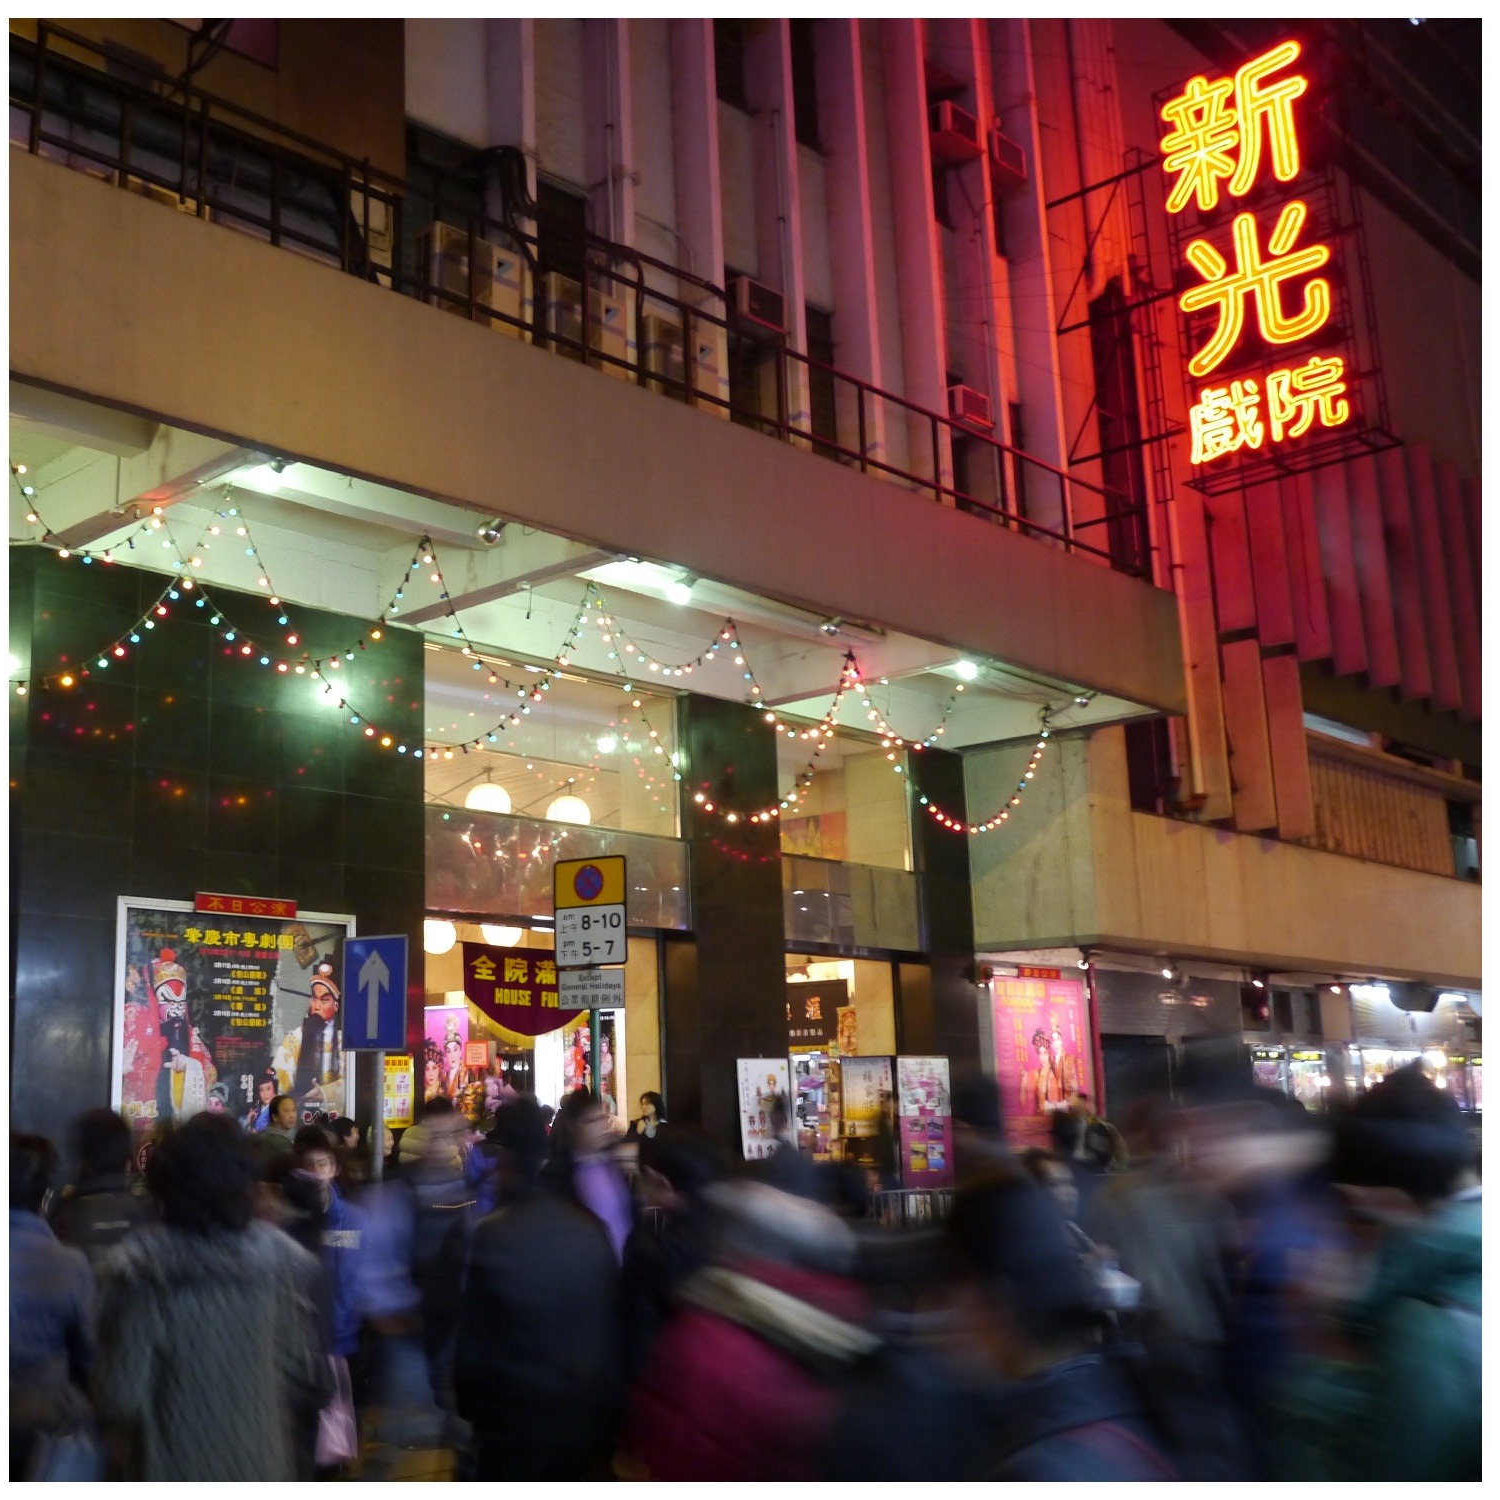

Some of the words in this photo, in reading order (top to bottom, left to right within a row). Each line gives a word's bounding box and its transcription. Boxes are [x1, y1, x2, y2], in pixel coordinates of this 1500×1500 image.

[581, 912, 621, 930] 8-10
[560, 924, 578, 934] 上午
[560, 950, 579, 959] 下午
[578, 973, 602, 982] Except
[561, 983, 588, 991] General
[589, 982, 622, 990] Holidays
[494, 987, 532, 1007] HOUSE
